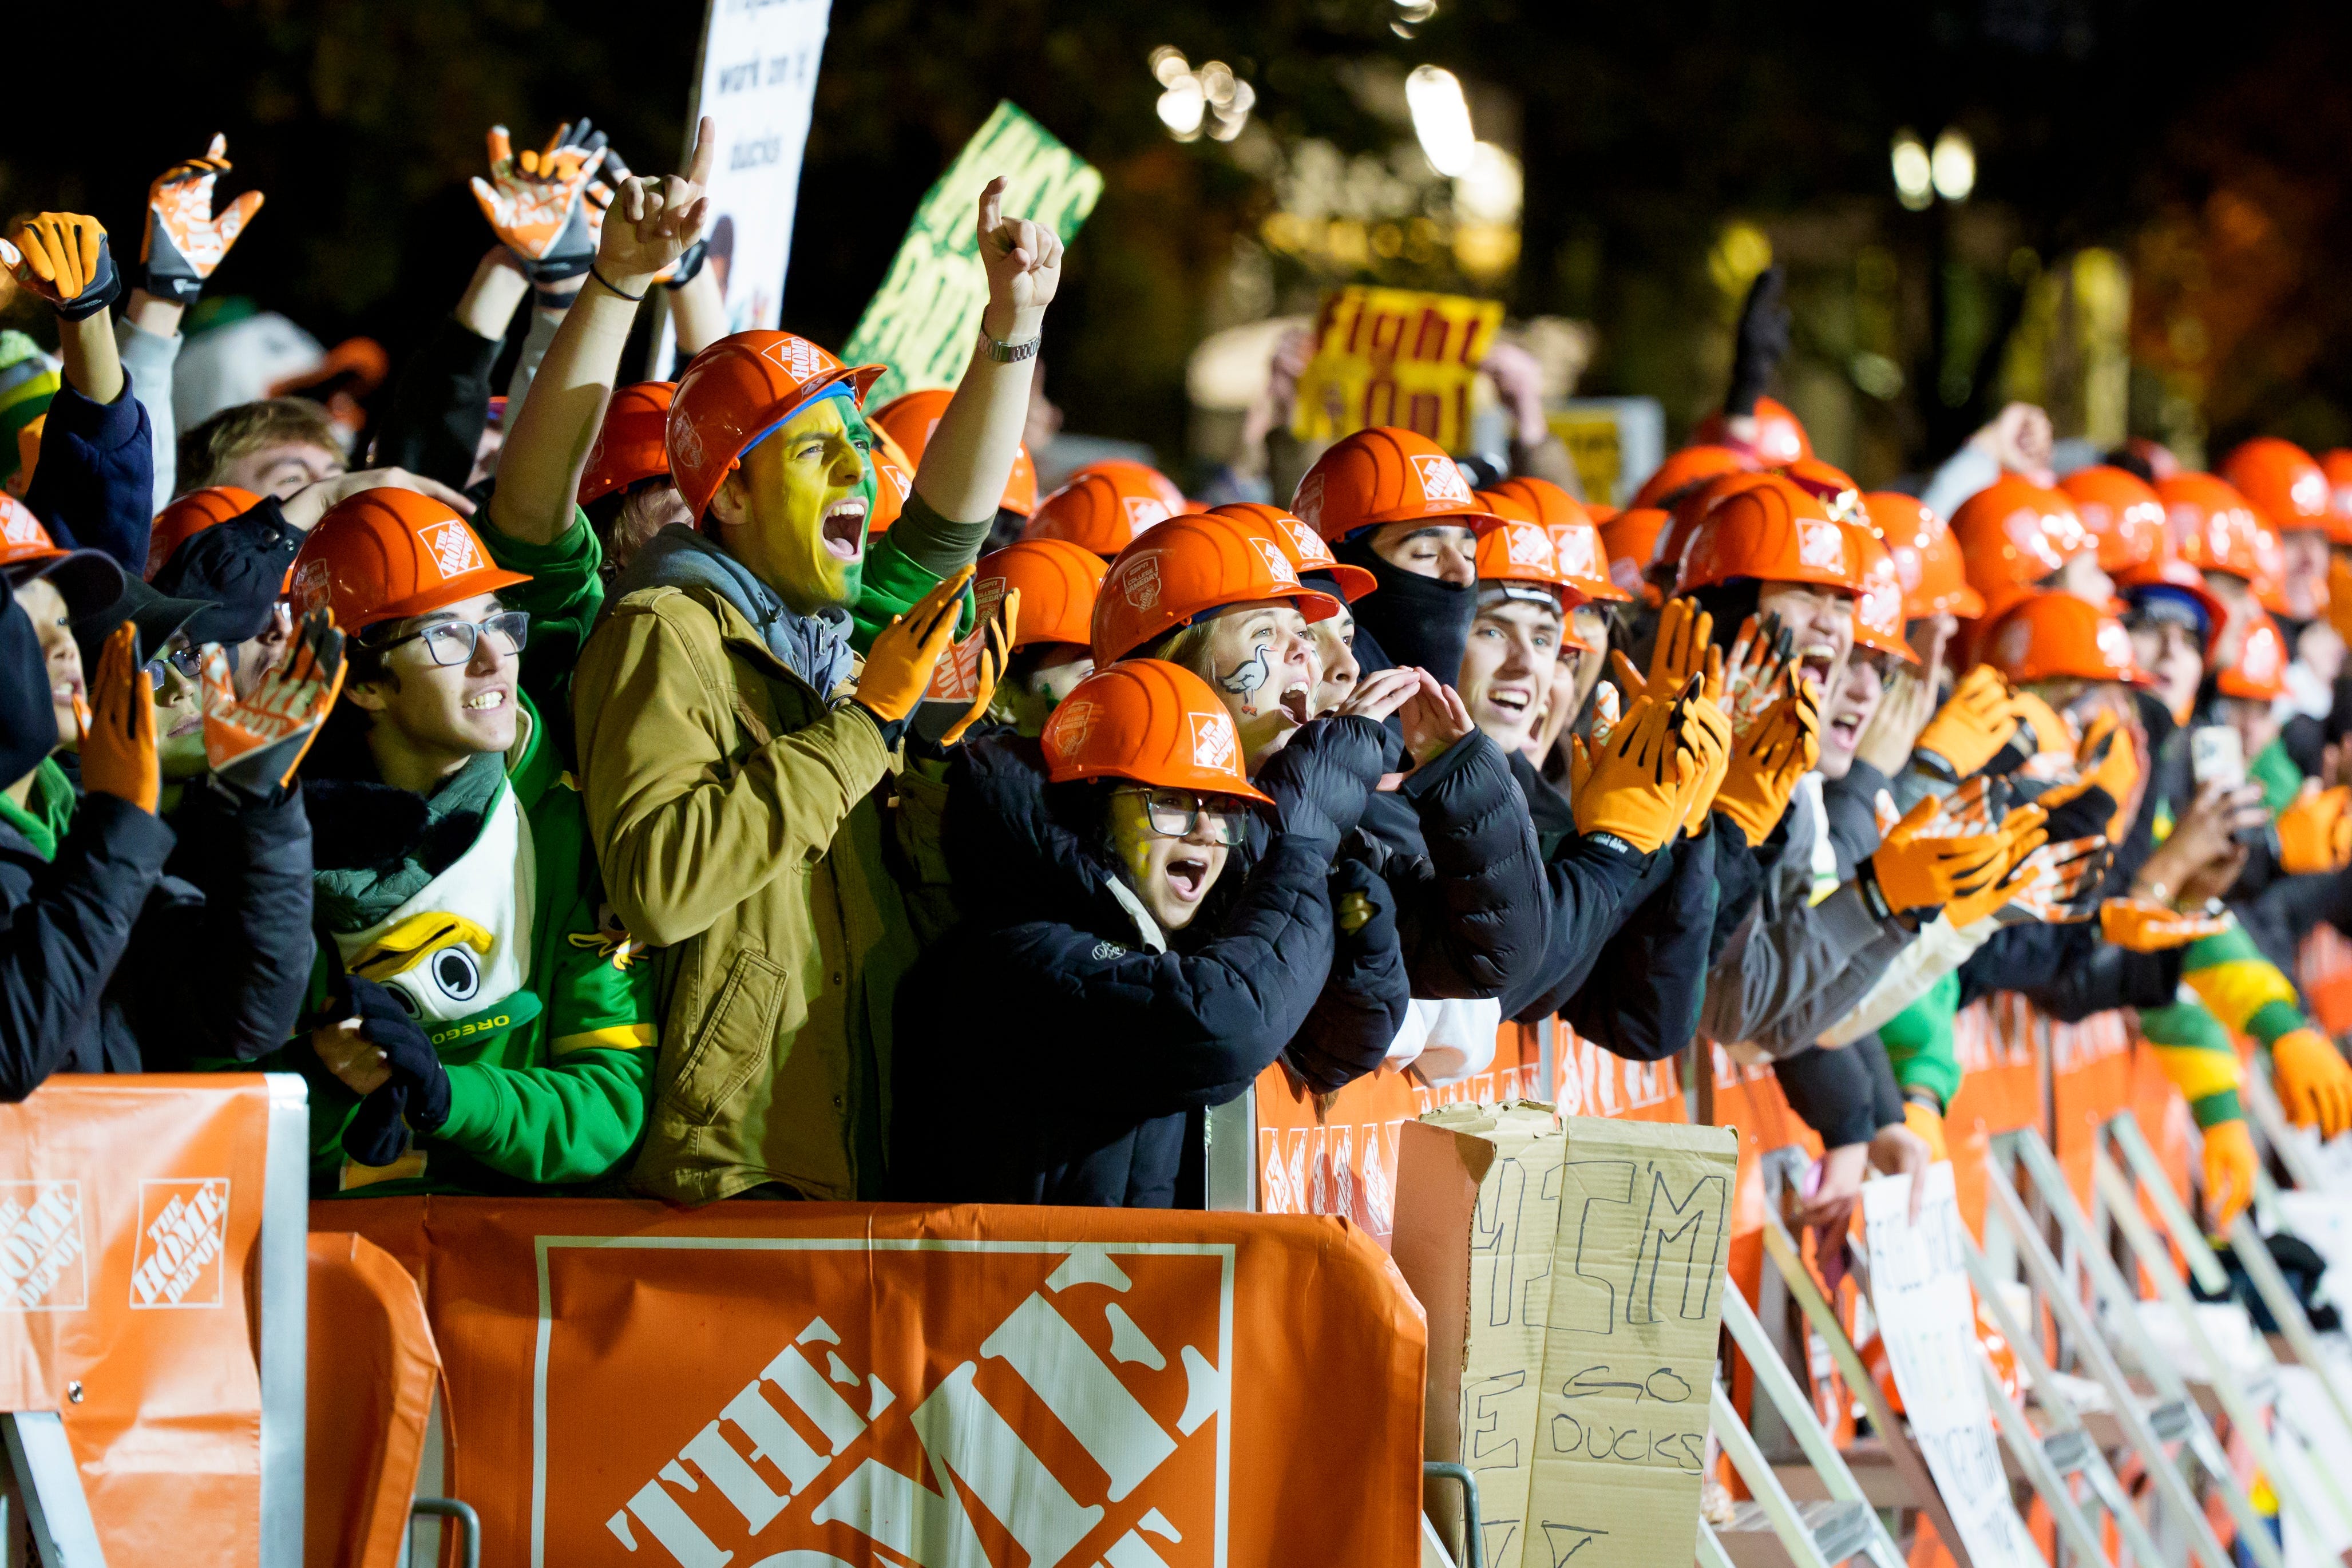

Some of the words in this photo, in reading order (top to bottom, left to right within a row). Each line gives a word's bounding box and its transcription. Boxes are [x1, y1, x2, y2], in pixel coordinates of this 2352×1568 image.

[781, 346, 791, 362] THE
[791, 338, 809, 379] HOME
[809, 346, 819, 372] DEPOT
[435, 529, 449, 551] THE
[439, 522, 466, 574] HOME
[459, 533, 473, 571] DEPOT
[1126, 572, 1158, 595] GAMEDAY
[431, 1015, 510, 1044] OREGO
[146, 1194, 186, 1244] THE
[133, 1180, 227, 1306] HOME
[18, 1228, 82, 1309] DEPOT
[164, 1225, 221, 1306] DEPOT
[1562, 1365, 1692, 1404] GO
[605, 1316, 896, 1568] THE
[1551, 1413, 1704, 1476] DUCKS
